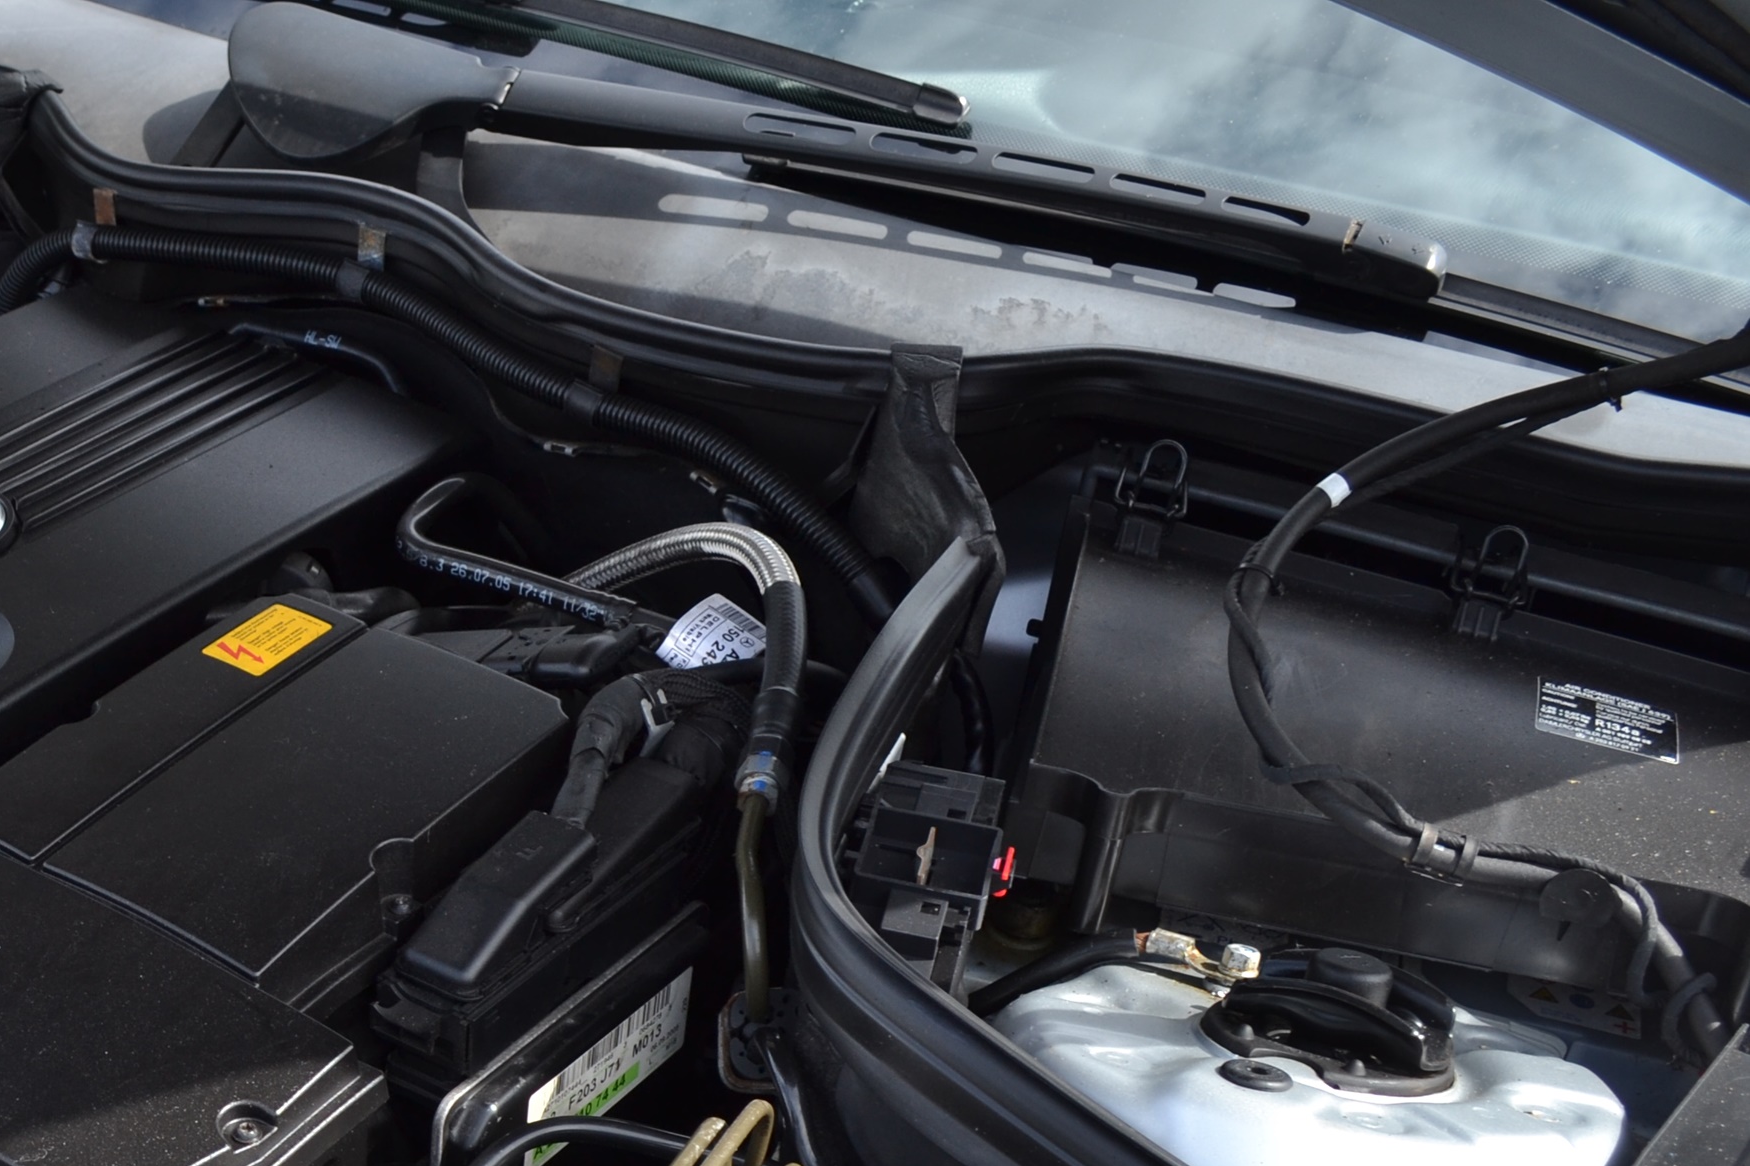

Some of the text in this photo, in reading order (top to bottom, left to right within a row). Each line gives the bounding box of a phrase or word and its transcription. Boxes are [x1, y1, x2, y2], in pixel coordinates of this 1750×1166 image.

[451, 561, 511, 591] 26.07.05
[518, 581, 553, 605] 17:41
[685, 616, 720, 652] DELPHI
[1583, 688, 1651, 710] CONDITIONER
[1595, 719, 1640, 736] R134a
[568, 1078, 597, 1111] F203
[631, 1023, 662, 1057] M013
[596, 1090, 609, 1107] 74
[613, 1075, 626, 1092] 44
